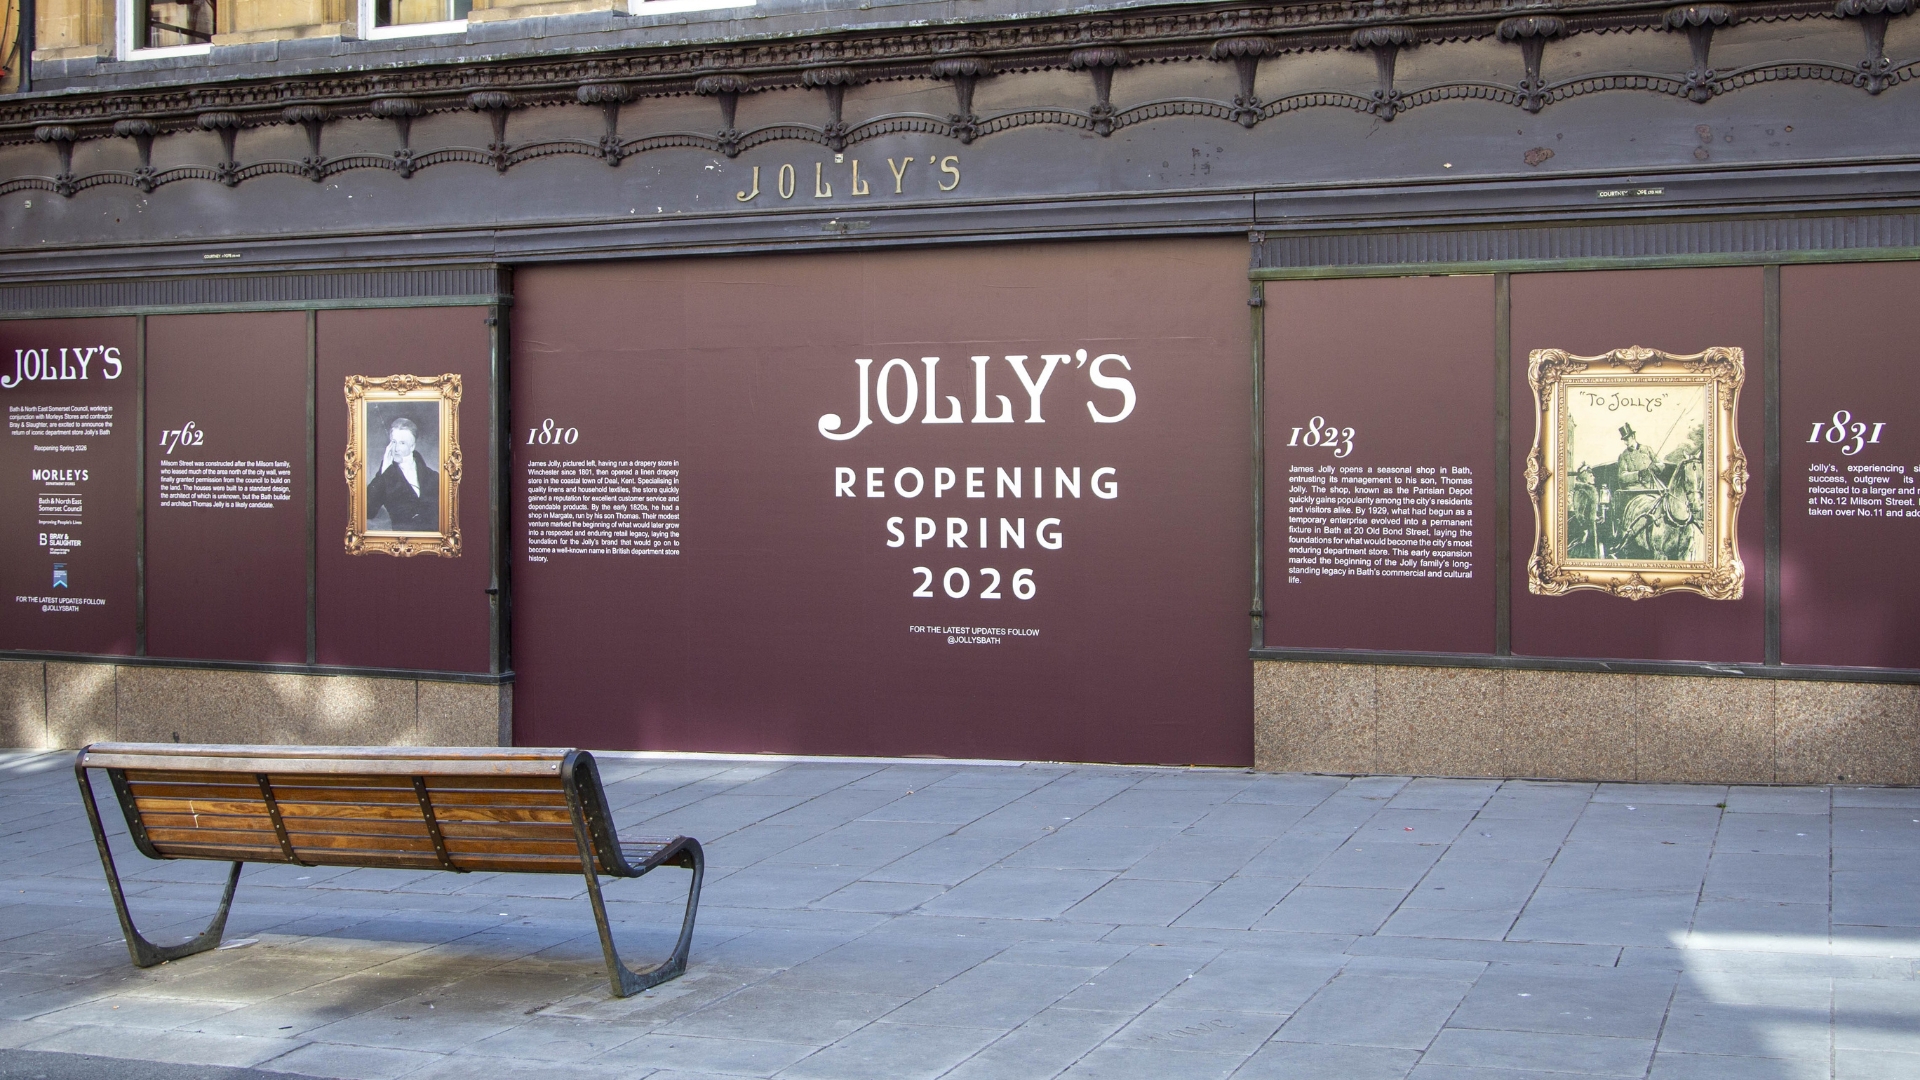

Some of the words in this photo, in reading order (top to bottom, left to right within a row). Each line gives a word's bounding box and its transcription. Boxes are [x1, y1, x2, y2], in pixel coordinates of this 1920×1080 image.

[736, 155, 961, 202] JOLLY'S
[1, 345, 123, 388] JOLLY'S
[817, 348, 1137, 441] JOLLY'S
[526, 418, 579, 444] 1810
[1287, 416, 1355, 458] 1823
[1806, 410, 1886, 456] 1831
[159, 421, 204, 455] 1762
[547, 460, 562, 469] Jolly,
[562, 460, 585, 469] pictured
[586, 460, 597, 468] left,
[598, 460, 617, 469] having
[634, 460, 656, 469] drapery
[1289, 465, 1314, 473] James
[1318, 465, 1336, 475] Jolly
[1340, 467, 1363, 476] opens
[1377, 465, 1412, 474] seasonal
[1416, 466, 1436, 476] shop
[1440, 466, 1447, 474] in
[1451, 466, 1473, 476] Bath,
[1808, 463, 1838, 474] Jolly's,
[1847, 464, 1905, 475] experiencing
[32, 469, 88, 480] MORLEYS
[1289, 475, 1326, 486] entrusting
[1329, 475, 1338, 483] its
[1341, 475, 1392, 486] management
[1394, 476, 1402, 484] to
[1405, 476, 1417, 484] his
[1420, 478, 1437, 486] son,
[1440, 476, 1473, 485] Thomas
[1808, 476, 1847, 484] success,
[1854, 475, 1890, 486] outgrew
[1903, 475, 1914, 484] its
[835, 466, 1118, 500] REOPENING
[1289, 485, 1308, 496] Jolly.
[1311, 485, 1326, 494] The
[1330, 486, 1351, 496] shop,
[1354, 486, 1380, 494] known
[1397, 486, 1409, 494] the
[1413, 486, 1444, 495] Parisian
[1449, 487, 1473, 497] Depot
[1808, 485, 1849, 494] relocated
[1852, 486, 1860, 494] to
[1870, 486, 1896, 497] larger
[1898, 486, 1915, 495] and
[1289, 495, 1315, 506] quickly
[1315, 496, 1336, 506] gains
[1337, 496, 1374, 507] popularity
[1375, 498, 1401, 507] among
[1403, 497, 1415, 505] the
[1416, 497, 1435, 508] city's
[1436, 497, 1473, 506] residents
[1808, 497, 1817, 505] at
[1820, 497, 1847, 505] No.12
[1850, 497, 1882, 506] Milsom
[1885, 497, 1915, 506] Street.
[1289, 505, 1303, 514] and
[1305, 506, 1332, 514] visitors
[1333, 506, 1353, 514] alike.
[1355, 506, 1366, 517] By
[1391, 507, 1410, 515] what
[1411, 507, 1426, 515] had
[1428, 507, 1453, 518] begun
[1808, 507, 1833, 516] taken
[1857, 508, 1883, 517] No.11
[1886, 508, 1903, 517] and
[886, 517, 1063, 550] SPRING
[1289, 525, 1311, 534] fixture
[1315, 526, 1321, 534] in
[1324, 526, 1341, 534] Bath
[1344, 526, 1352, 535] at
[1354, 527, 1364, 535] 20
[1366, 527, 1380, 535] Old
[1382, 527, 1403, 536] Bond
[1406, 527, 1431, 537] Street,
[1434, 528, 1457, 539] laying
[1460, 528, 1472, 537] the
[528, 555, 548, 563] history.
[1289, 566, 1320, 577] standing
[1322, 567, 1347, 578] legacy
[1348, 567, 1355, 576] in
[1356, 568, 1380, 576] Bath's
[1382, 568, 1426, 577] commercial
[1427, 569, 1442, 577] and
[1444, 569, 1472, 578] cultural
[912, 566, 1036, 600] 2026
[1288, 576, 1302, 584] life.
[28, 596, 38, 604] THE
[58, 597, 82, 605] UPDATES
[83, 598, 106, 606] FOLLOW
[909, 625, 926, 634] FOR
[926, 625, 942, 634] THE
[943, 626, 970, 634] LATEST
[971, 626, 1007, 635] UPDATES
[1007, 627, 1040, 636] FOLLOW
[947, 636, 1001, 645] @JOLLYSBATH
